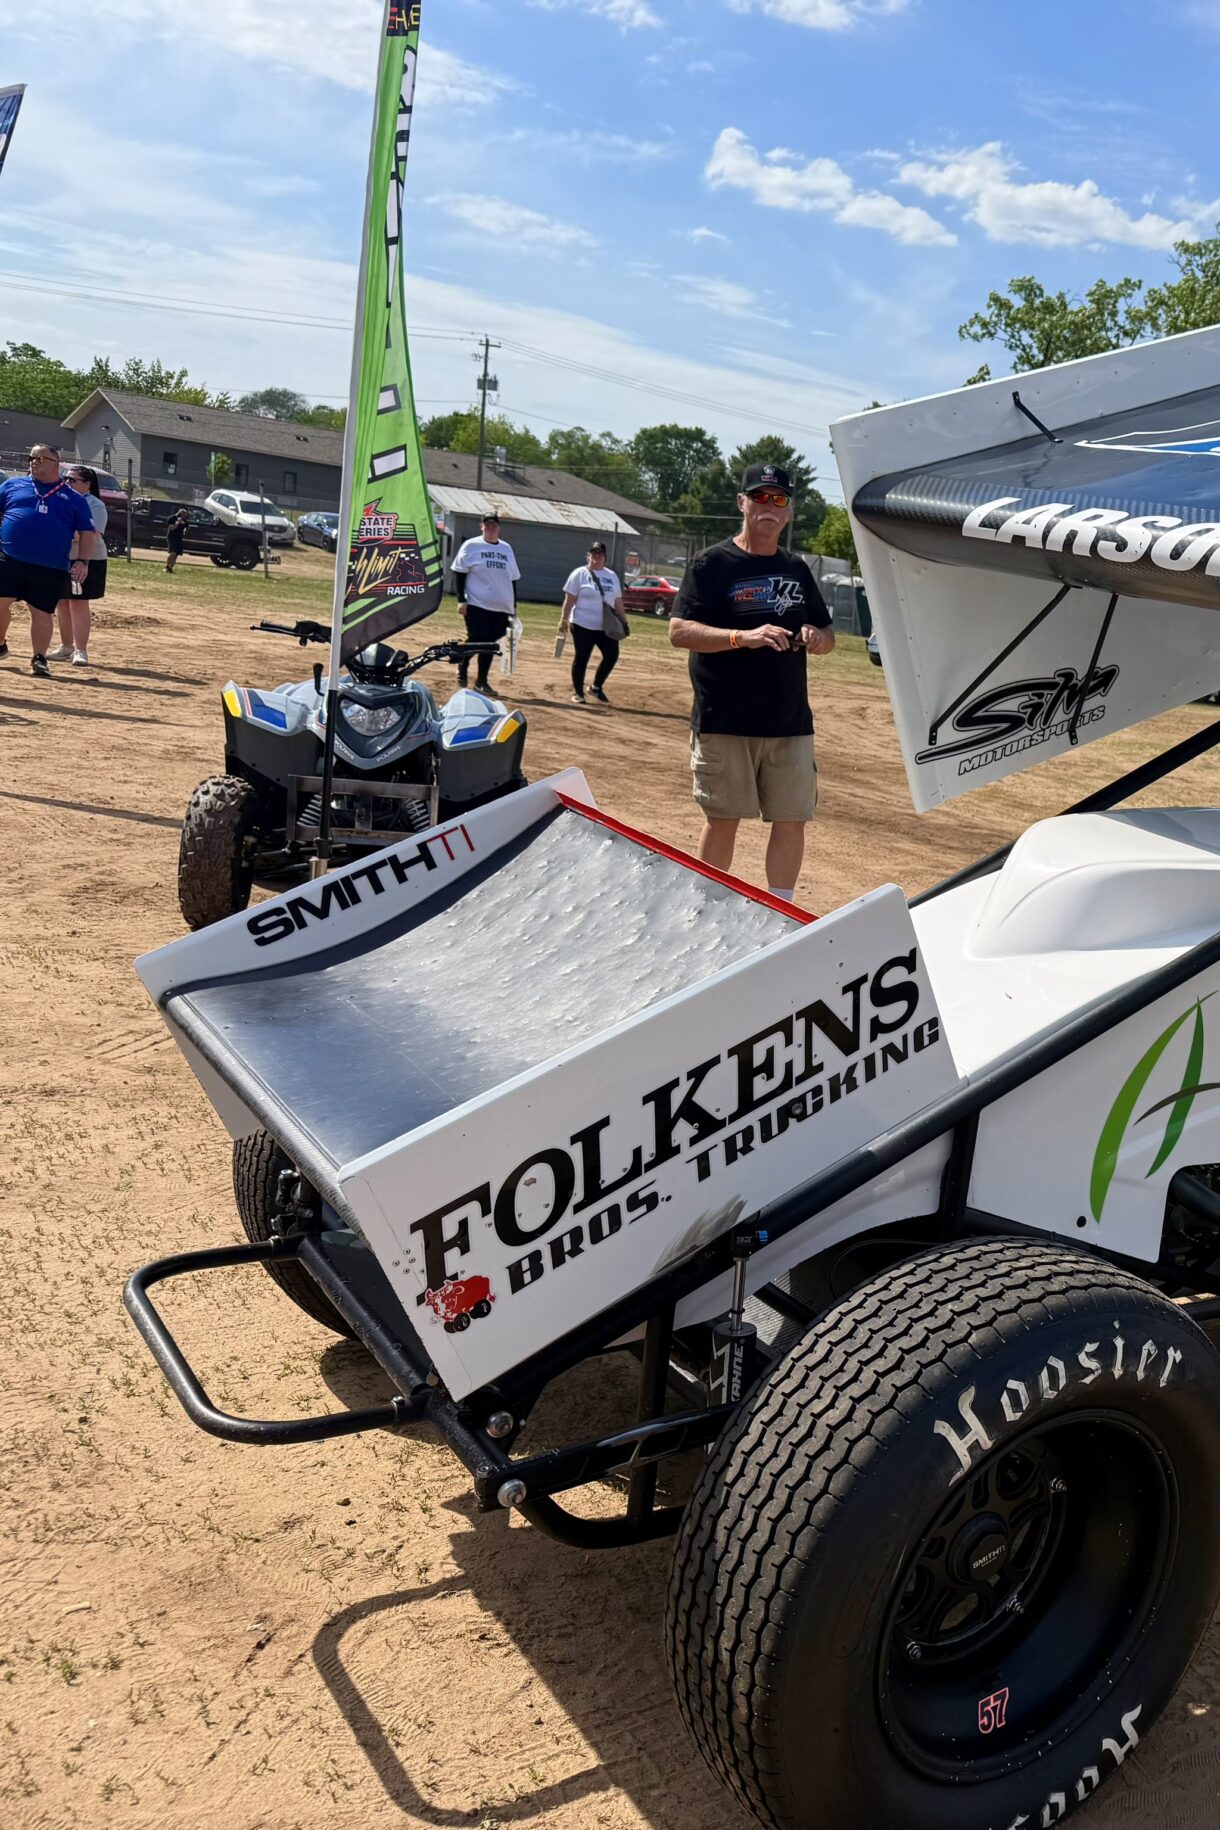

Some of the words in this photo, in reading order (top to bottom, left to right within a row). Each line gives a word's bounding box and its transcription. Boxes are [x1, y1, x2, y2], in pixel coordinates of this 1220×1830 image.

[359, 527, 390, 536] ERIES
[361, 517, 393, 526] STATE
[486, 560, 506, 570] EFFORT
[387, 585, 425, 596] RACING
[410, 948, 920, 1305] FOLKENS
[507, 1192, 672, 1294] BROS.
[686, 1016, 940, 1182] TRUCKING
[933, 1320, 1184, 1486] Hoosier
[978, 1686, 1010, 1734] 57
